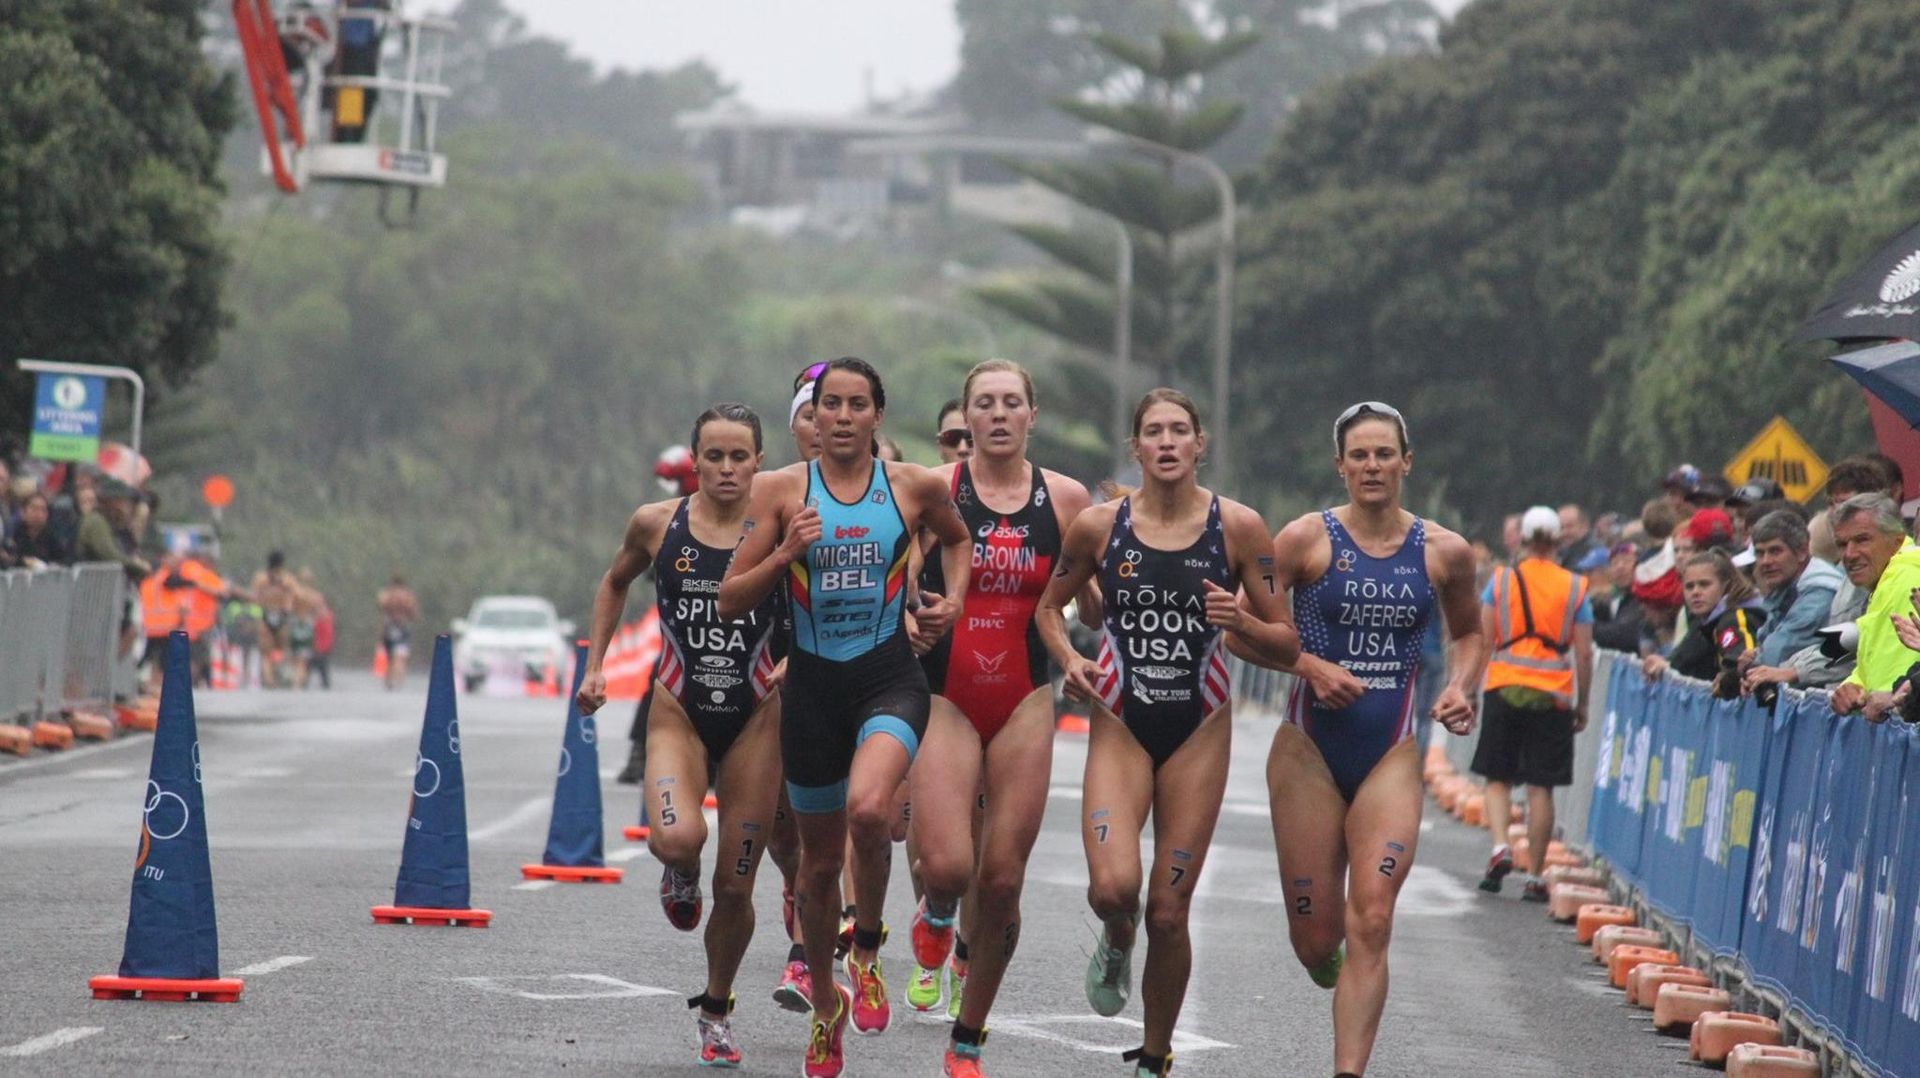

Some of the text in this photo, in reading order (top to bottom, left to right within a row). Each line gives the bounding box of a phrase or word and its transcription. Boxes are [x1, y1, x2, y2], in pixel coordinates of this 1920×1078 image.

[994, 524, 1029, 538] asics
[816, 542, 884, 568] MICHEL
[971, 542, 1035, 572] BROWN
[820, 568, 876, 592] BEL
[978, 571, 1023, 594] CAN
[1262, 575, 1275, 594] 7
[969, 617, 1005, 631] pwc
[1121, 610, 1204, 632] COOK
[1339, 603, 1417, 627] ZAFERES
[687, 627, 746, 651] USA
[1129, 637, 1192, 661] USA
[1349, 632, 1396, 656] USA
[1339, 660, 1401, 671] SRAM
[1149, 689, 1191, 697] NEW YORK
[1094, 824, 1108, 843] 7
[144, 865, 165, 881] ITU
[1169, 866, 1185, 886] 7
[1378, 856, 1397, 878] 2
[1296, 896, 1312, 915] 2
